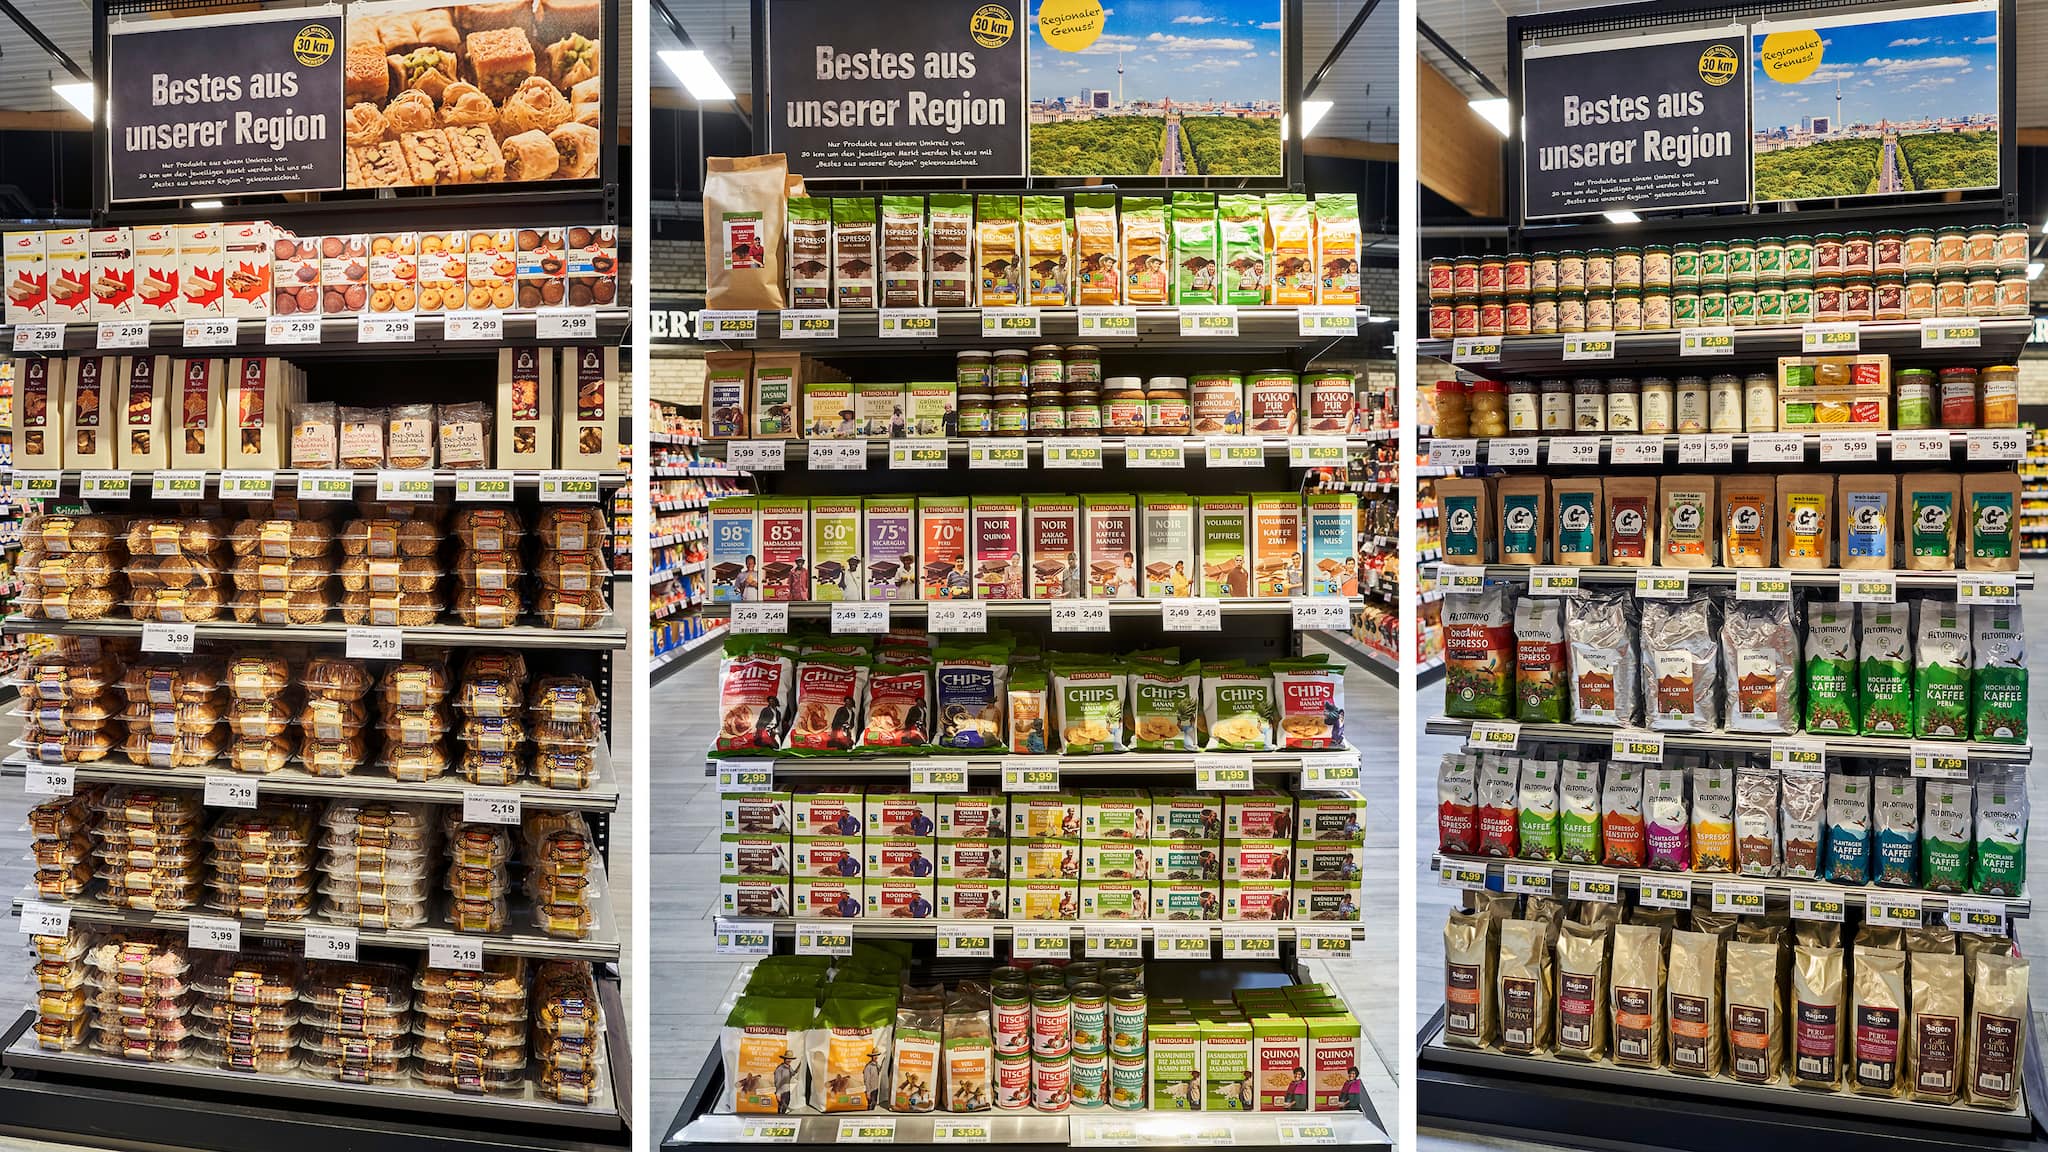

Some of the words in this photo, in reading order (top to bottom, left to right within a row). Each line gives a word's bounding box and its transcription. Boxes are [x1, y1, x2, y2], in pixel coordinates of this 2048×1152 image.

[1041, 8, 1100, 26] Regionaler
[974, 18, 988, 31] 30
[991, 20, 1008, 34] km
[1051, 20, 1094, 36] Genuss!
[298, 39, 310, 50] 30
[313, 40, 328, 52] km
[1764, 40, 1819, 60] Regionaler
[816, 46, 916, 80] Bestes
[924, 51, 976, 80] aus
[1702, 59, 1714, 70] 30
[1718, 61, 1732, 72] km
[1774, 52, 1814, 70] Genuss!
[152, 72, 242, 106] Bestes
[250, 72, 298, 99] aus
[787, 100, 900, 127] unserer
[909, 91, 1006, 134] Region
[1564, 95, 1650, 127] Bestes
[1658, 91, 1705, 118] aus
[125, 119, 228, 152] unserer
[235, 108, 326, 151] Region
[1539, 140, 1637, 172] unserer
[1644, 126, 1731, 167] Region
[857, 150, 895, 158] jeweiligen
[794, 236, 826, 245] ESPRESSO
[838, 234, 871, 243] ESPRESSO
[292, 323, 314, 332] 2,99
[386, 323, 409, 332] 2,99
[562, 319, 586, 328] 2,99
[723, 320, 753, 330] 22,95
[804, 319, 829, 329] 4,99
[1006, 318, 1031, 328] 4,99
[36, 330, 56, 340] 2,99
[122, 328, 143, 337] 2,99
[1706, 336, 1728, 346] 2,99
[1475, 345, 1495, 354] 2,99
[1258, 393, 1289, 401] KAKAO
[1266, 401, 1282, 409] PUR
[1636, 445, 1657, 454] 4,99
[1775, 443, 1797, 452] 6,49
[1919, 442, 1942, 450] 5,99
[734, 450, 754, 458] 5,99
[762, 450, 781, 458] 5,99
[840, 448, 860, 456] 4,99
[994, 450, 1018, 459] 3,49
[1232, 448, 1257, 458] 5,99
[1451, 449, 1471, 457] 7,99
[1510, 448, 1529, 456] 3,99
[32, 480, 52, 489] 2,79
[103, 480, 124, 489] 2,79
[404, 481, 428, 490] 1,99
[567, 481, 592, 490] 2,79
[984, 521, 1009, 529] NOIR
[1041, 520, 1066, 530] NOIR
[1098, 520, 1123, 529] NOIR
[721, 526, 750, 540] 98%
[771, 526, 800, 540] 85%
[824, 525, 854, 539] 80%
[877, 525, 906, 540] 75%
[932, 525, 962, 540] 70%
[983, 533, 1011, 541] QUINOA
[1268, 537, 1287, 545] ZIMT
[1458, 576, 1479, 585] 3,99
[1985, 586, 2009, 595] 3,99
[1449, 612, 1489, 622] ALTOMAYO
[1451, 630, 1484, 638] ORGANIC
[1810, 626, 1846, 634] ALTOMAYO
[167, 634, 190, 644] 3,99
[1448, 639, 1488, 648] ESPRESSO
[372, 639, 396, 649] 2,19
[730, 669, 778, 681] CHIPS
[942, 674, 991, 686] CHIPS
[1812, 682, 1847, 691] KAFFEE
[1069, 689, 1114, 702] CHIPS
[1141, 687, 1186, 699] CHIPS
[1288, 686, 1330, 698] CHIPS
[1488, 732, 1514, 742] 16,99
[1631, 744, 1658, 753] 15,99
[1794, 752, 1817, 761] 7,99
[1029, 772, 1052, 781] 3,99
[1329, 768, 1353, 778] 1,99
[47, 776, 67, 786] 3,99
[743, 773, 766, 783] 2,99
[1606, 831, 1639, 839] SENSITIVO
[1882, 842, 1912, 850] PLANTAGEN
[1882, 849, 1912, 857] KAFFEE
[1526, 876, 1546, 885] 4,99
[41, 916, 62, 927] 2,19
[1973, 914, 1996, 923] 4,99
[822, 936, 846, 945] 2,79
[1180, 939, 1204, 948] 2,79
[328, 941, 350, 952] 3,99
[453, 950, 476, 961] 2,19
[1509, 988, 1530, 997] Sagers
[1074, 1013, 1103, 1023] ANANAS
[1806, 1011, 1828, 1021] Sagers
[1807, 1028, 1825, 1037] PERU
[1986, 1023, 2011, 1034] Sagers
[1262, 1050, 1299, 1059] QUINOA
[766, 1128, 790, 1136] 3,79
